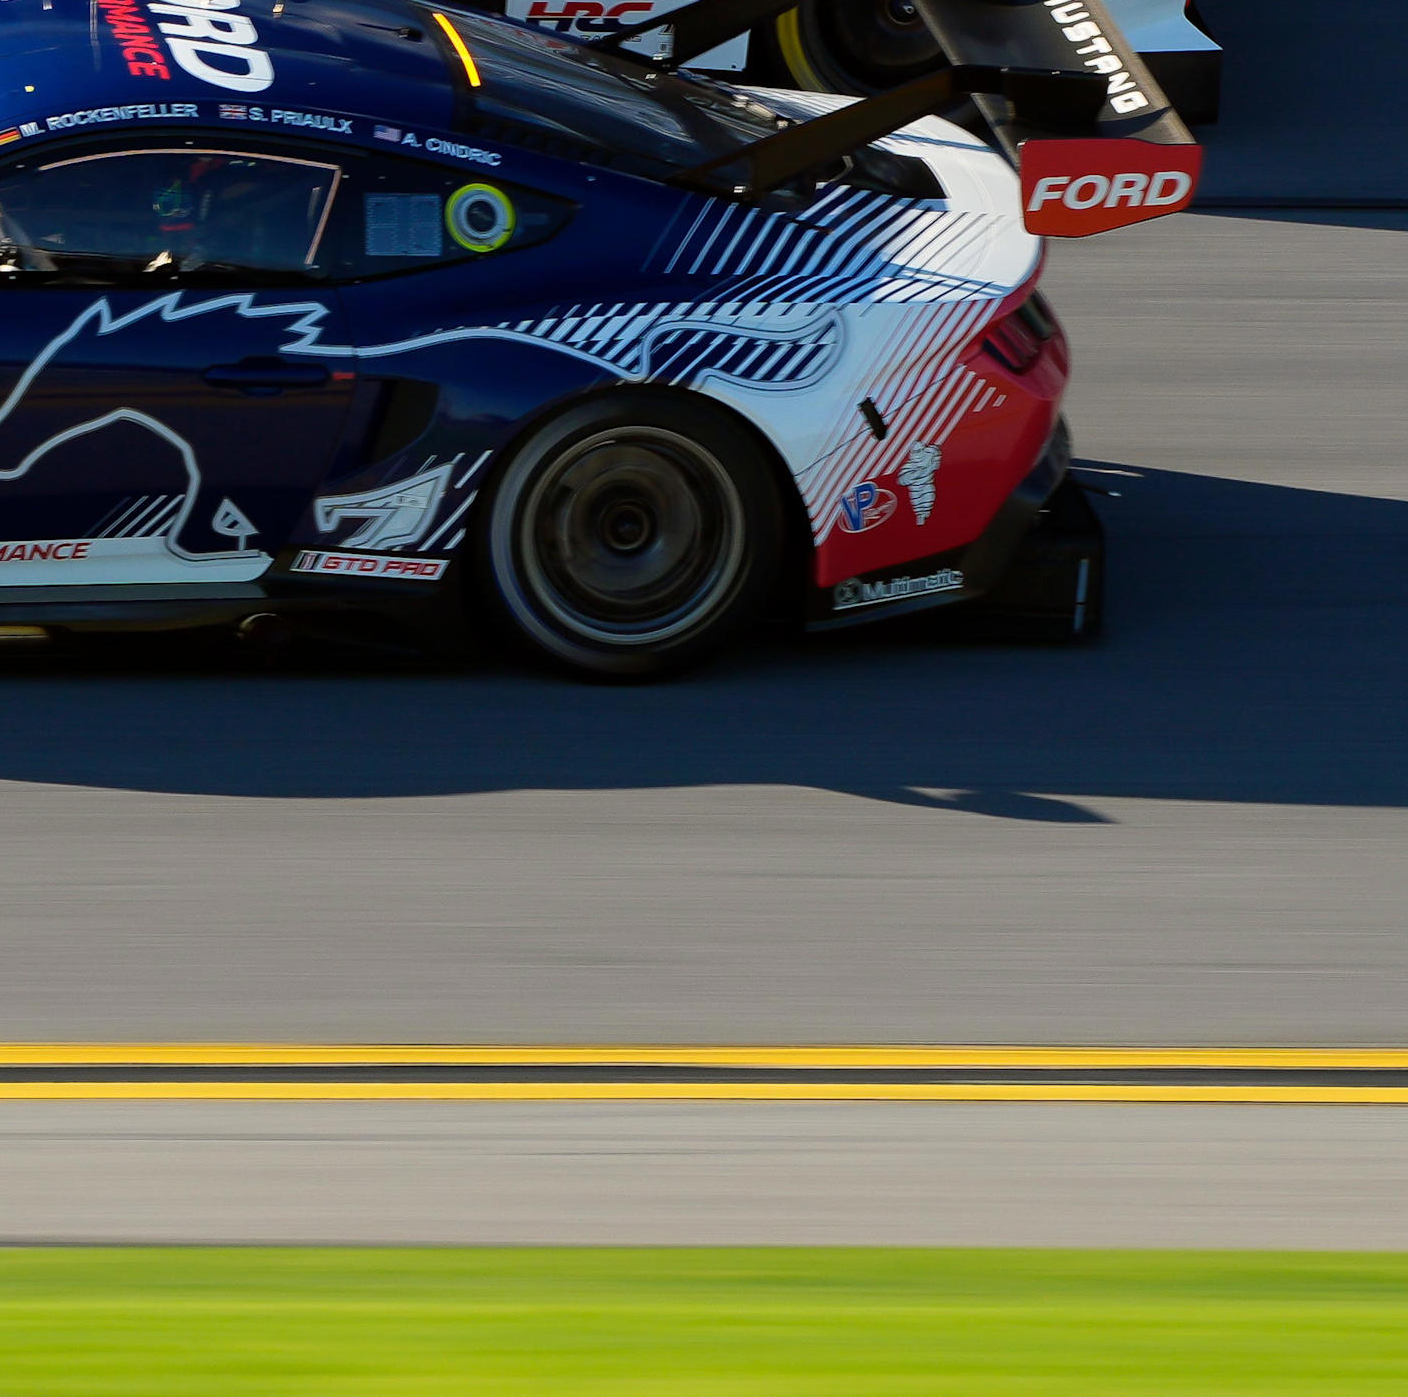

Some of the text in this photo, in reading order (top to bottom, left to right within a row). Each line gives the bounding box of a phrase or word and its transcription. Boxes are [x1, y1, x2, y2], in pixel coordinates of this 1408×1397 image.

[525, 1, 655, 34] HRC
[46, 103, 200, 131] ROCKENFELLER
[248, 106, 354, 134] S. PRIAULX
[401, 132, 502, 166] A. CINDRIC
[1025, 170, 1193, 212] FORD
[841, 481, 877, 531] VP
[322, 556, 442, 576] GTD PRO
